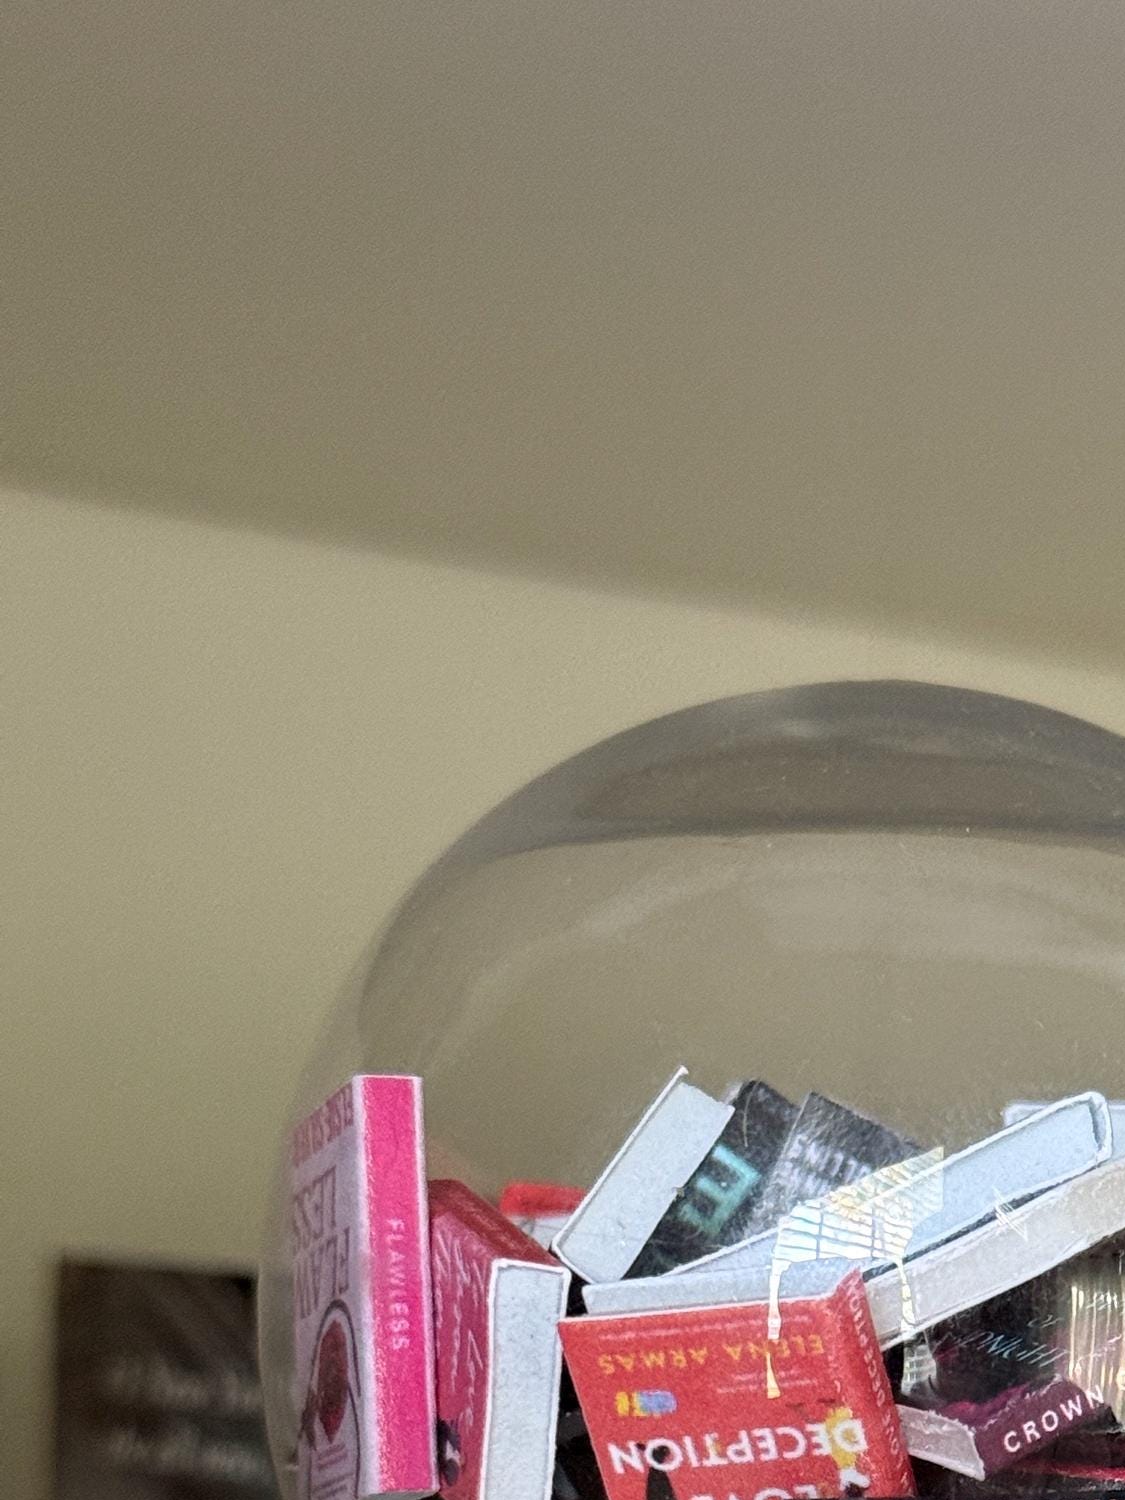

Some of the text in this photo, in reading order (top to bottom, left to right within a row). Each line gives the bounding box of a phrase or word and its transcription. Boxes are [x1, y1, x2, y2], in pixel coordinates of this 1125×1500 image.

[386, 1217, 411, 1350] FLAWLESS
[597, 1333, 825, 1376] ELENA ARMAS
[605, 1418, 869, 1475] DECEPTION
[1003, 1387, 1104, 1455] CROWN
